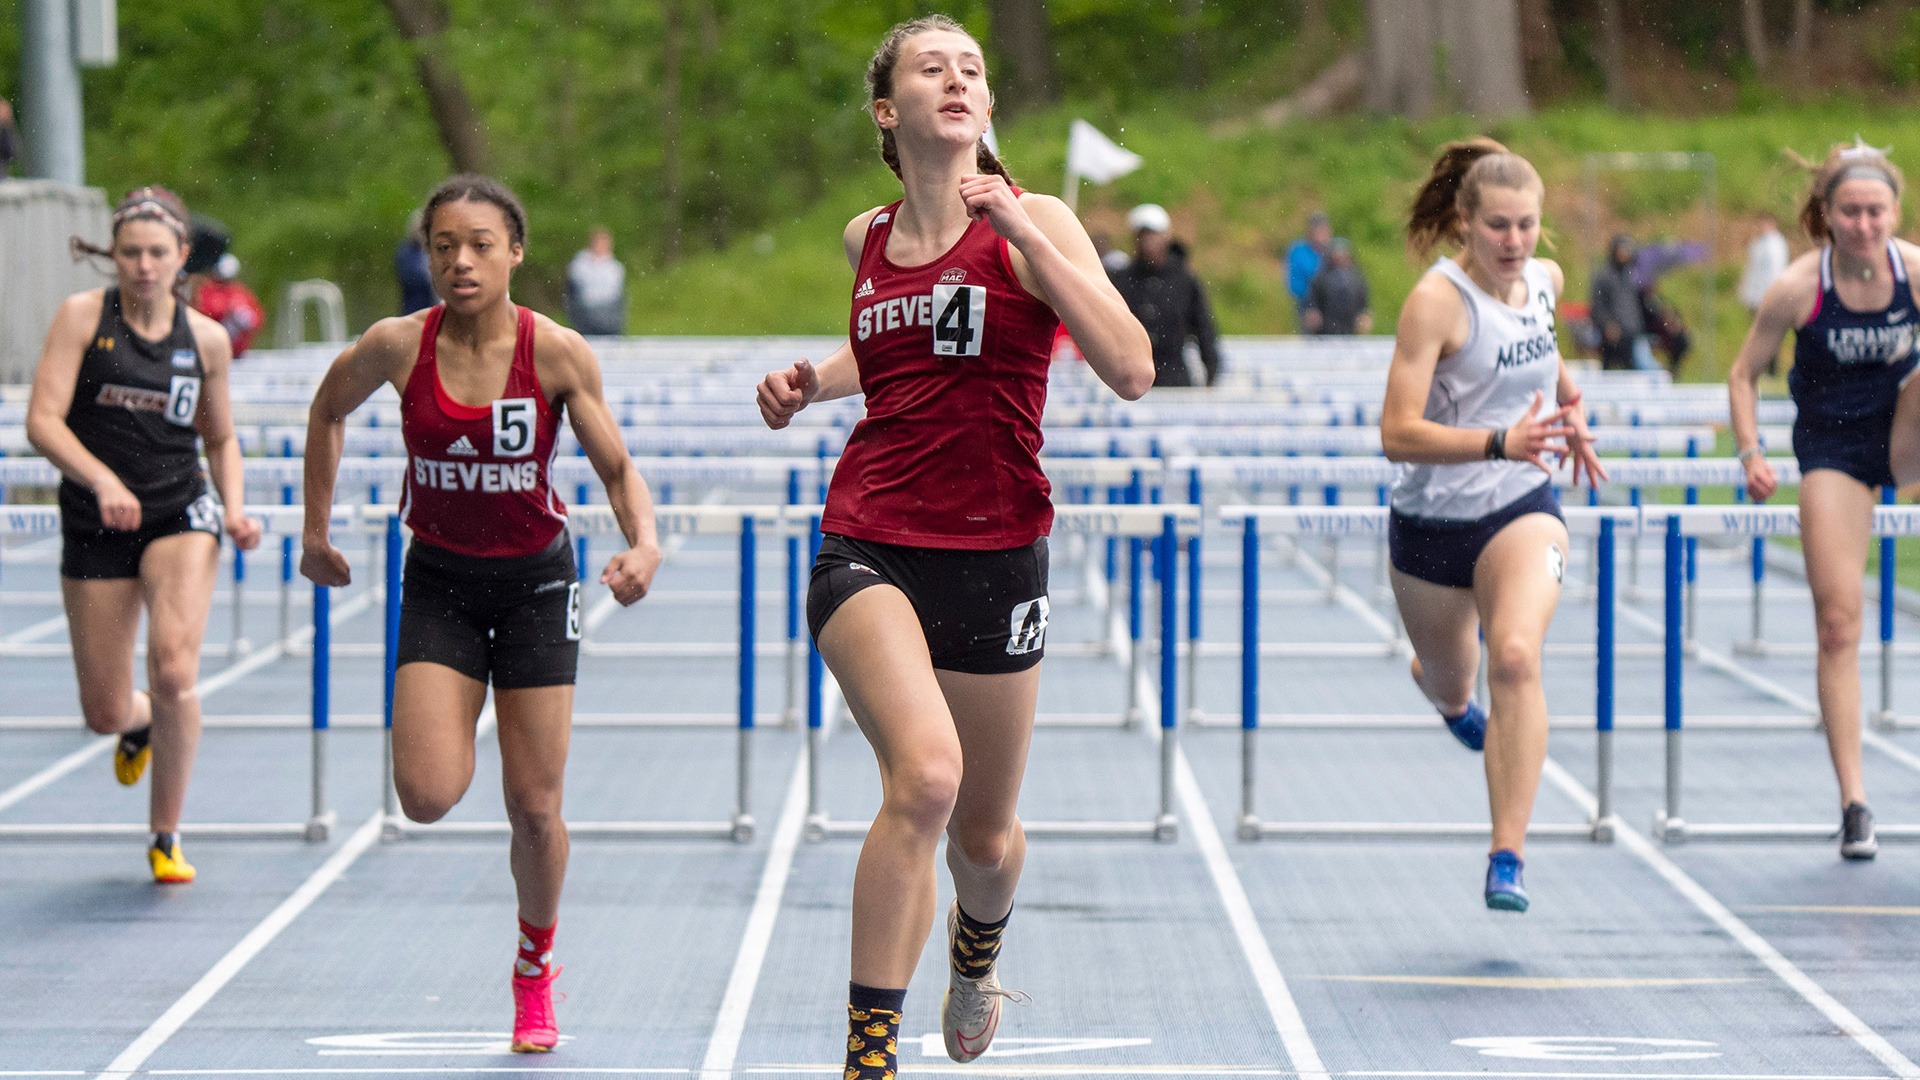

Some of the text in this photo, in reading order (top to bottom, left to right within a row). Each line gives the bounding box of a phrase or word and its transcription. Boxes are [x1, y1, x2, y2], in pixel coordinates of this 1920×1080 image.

[857, 295, 933, 341] STEVE
[936, 287, 974, 354] 4
[1496, 335, 1557, 371] MESSIA
[174, 383, 194, 418] 6
[500, 404, 528, 450] 5
[414, 455, 538, 493] STEVENS
[1014, 600, 1042, 650] 4
